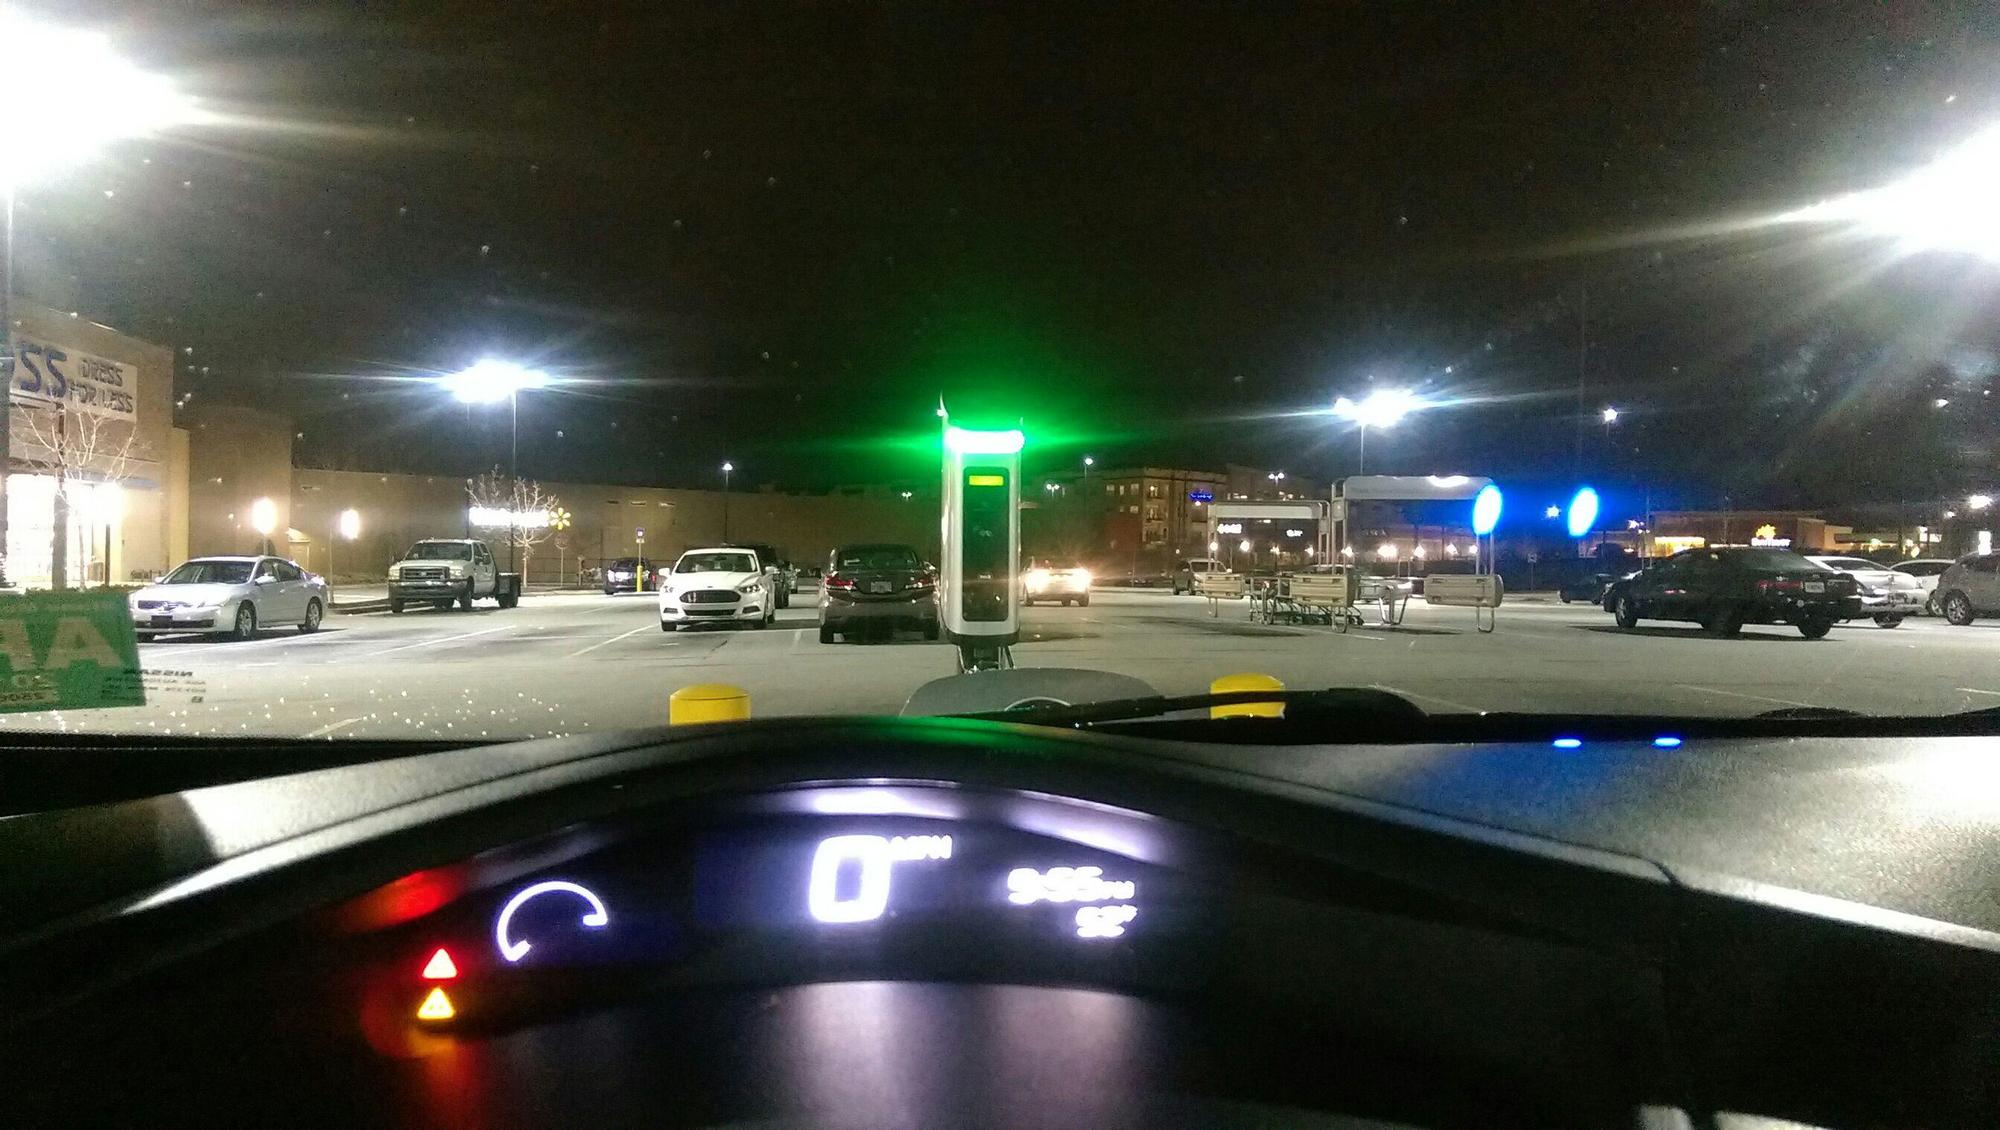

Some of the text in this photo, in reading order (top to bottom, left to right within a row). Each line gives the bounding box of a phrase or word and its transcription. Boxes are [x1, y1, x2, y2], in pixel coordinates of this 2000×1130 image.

[8, 340, 67, 398] SS
[79, 357, 123, 387] DRESS
[69, 380, 134, 413] FOR LESS
